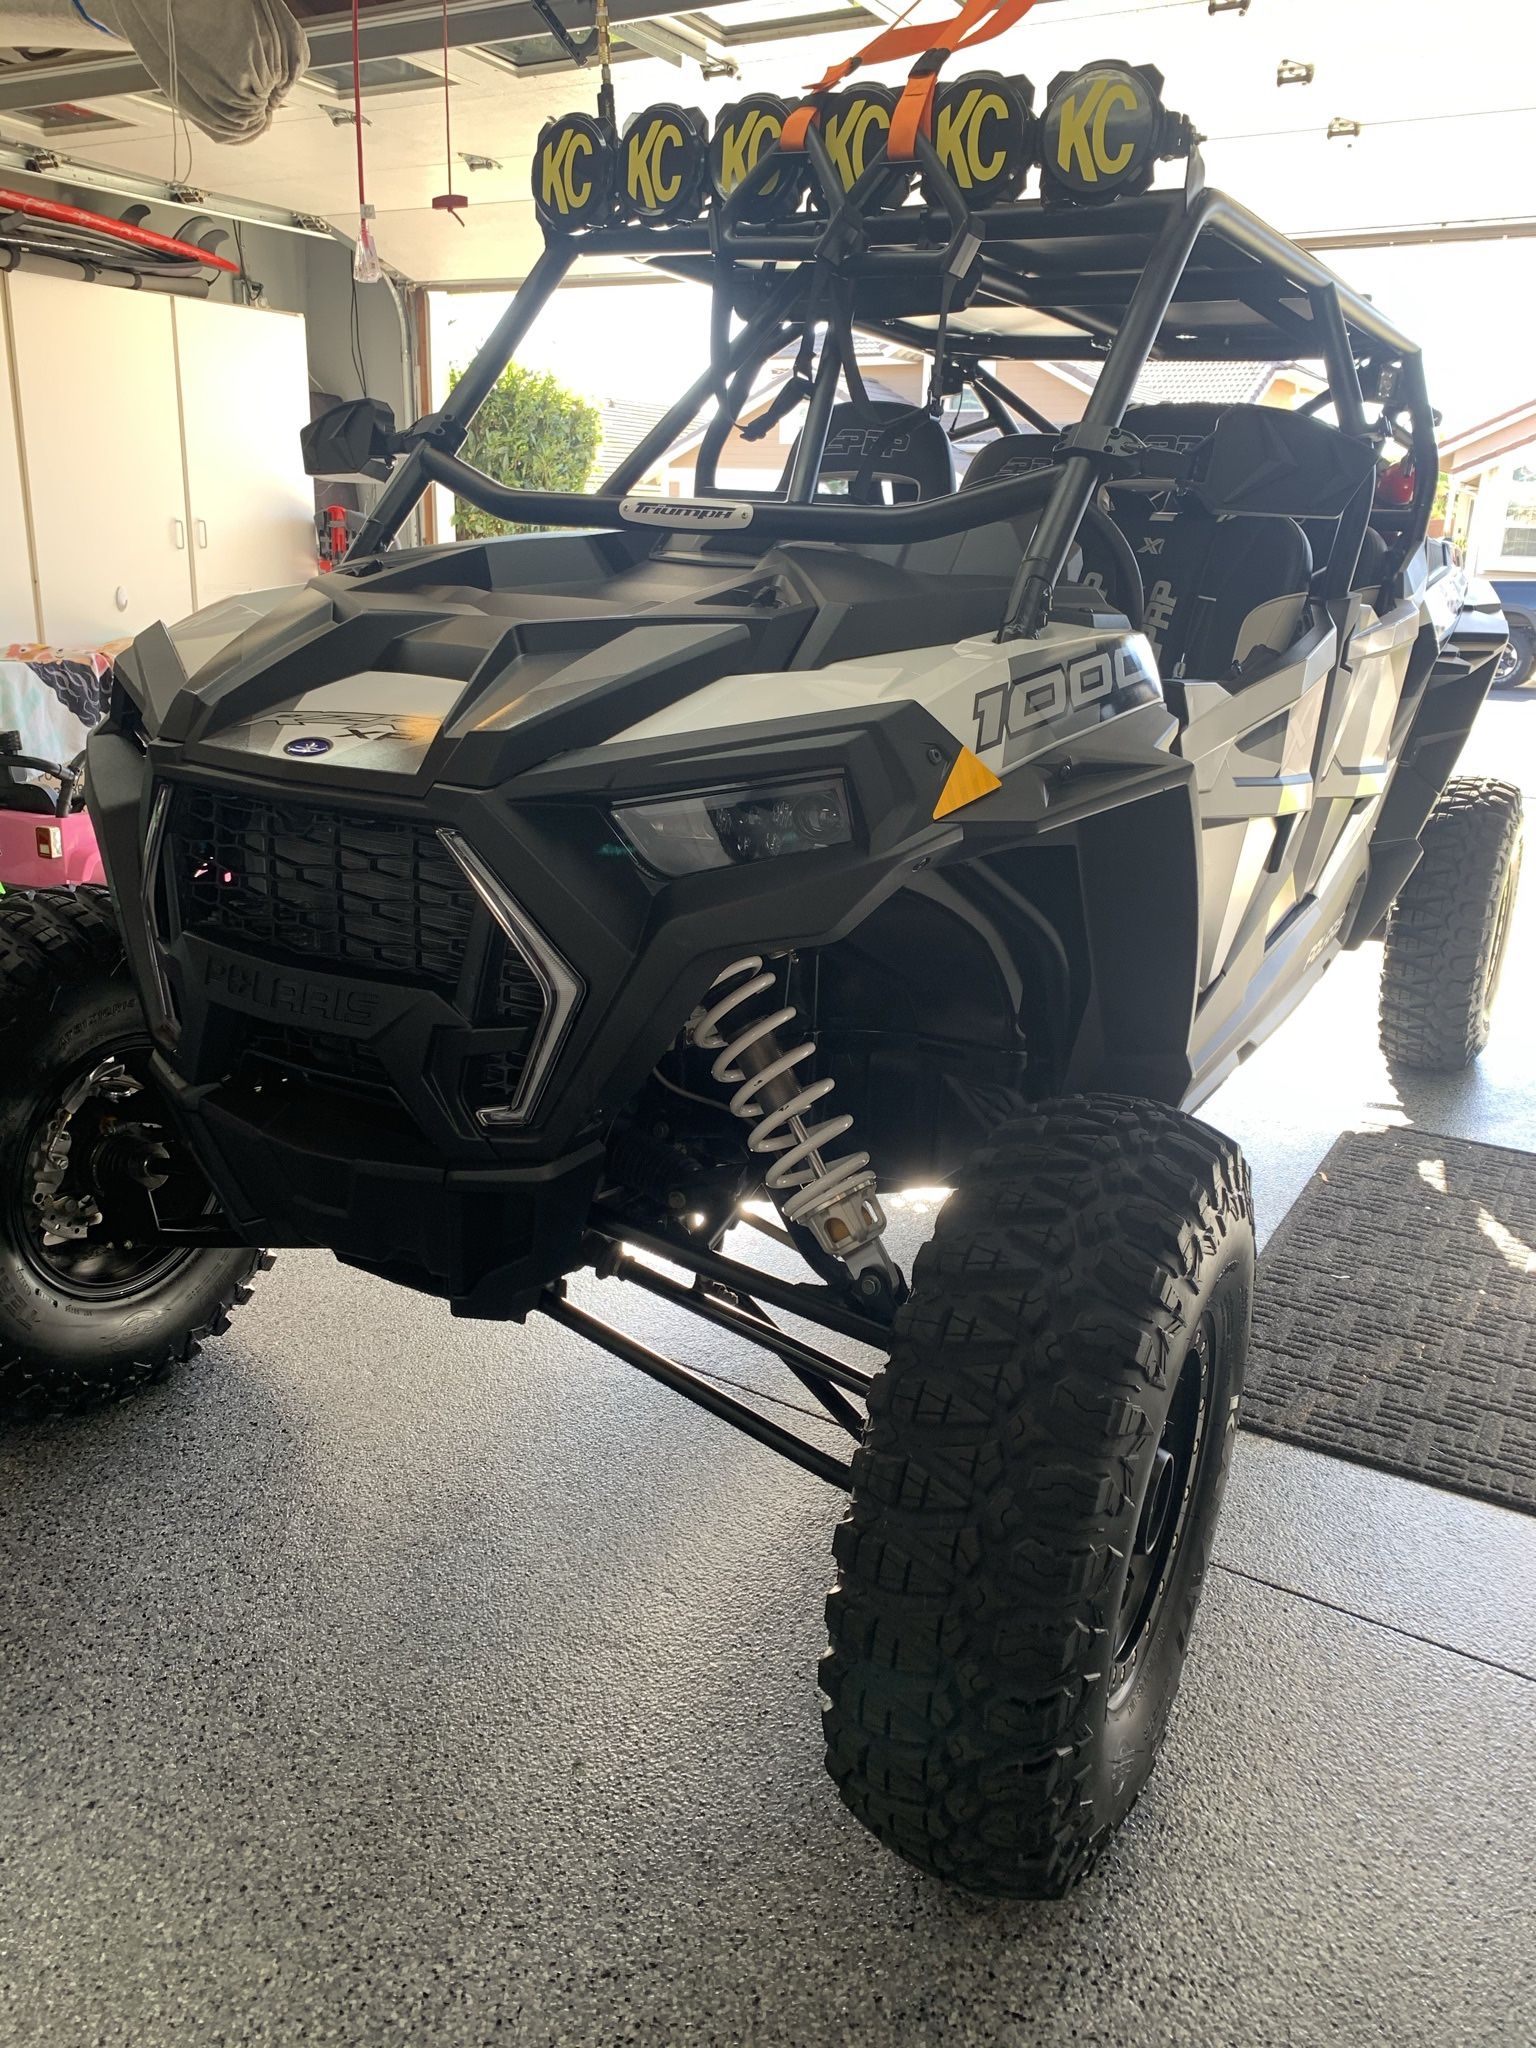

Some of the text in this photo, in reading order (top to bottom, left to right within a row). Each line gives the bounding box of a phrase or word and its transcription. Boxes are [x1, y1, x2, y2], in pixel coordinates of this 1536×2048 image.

[542, 128, 593, 214] KC
[627, 119, 684, 208] KC
[721, 110, 782, 196] KC
[825, 100, 892, 193] KC
[935, 88, 1009, 189] KC
[1057, 77, 1135, 182] KC
[334, 728, 415, 742] XP
[204, 955, 380, 1026] POLARIS
